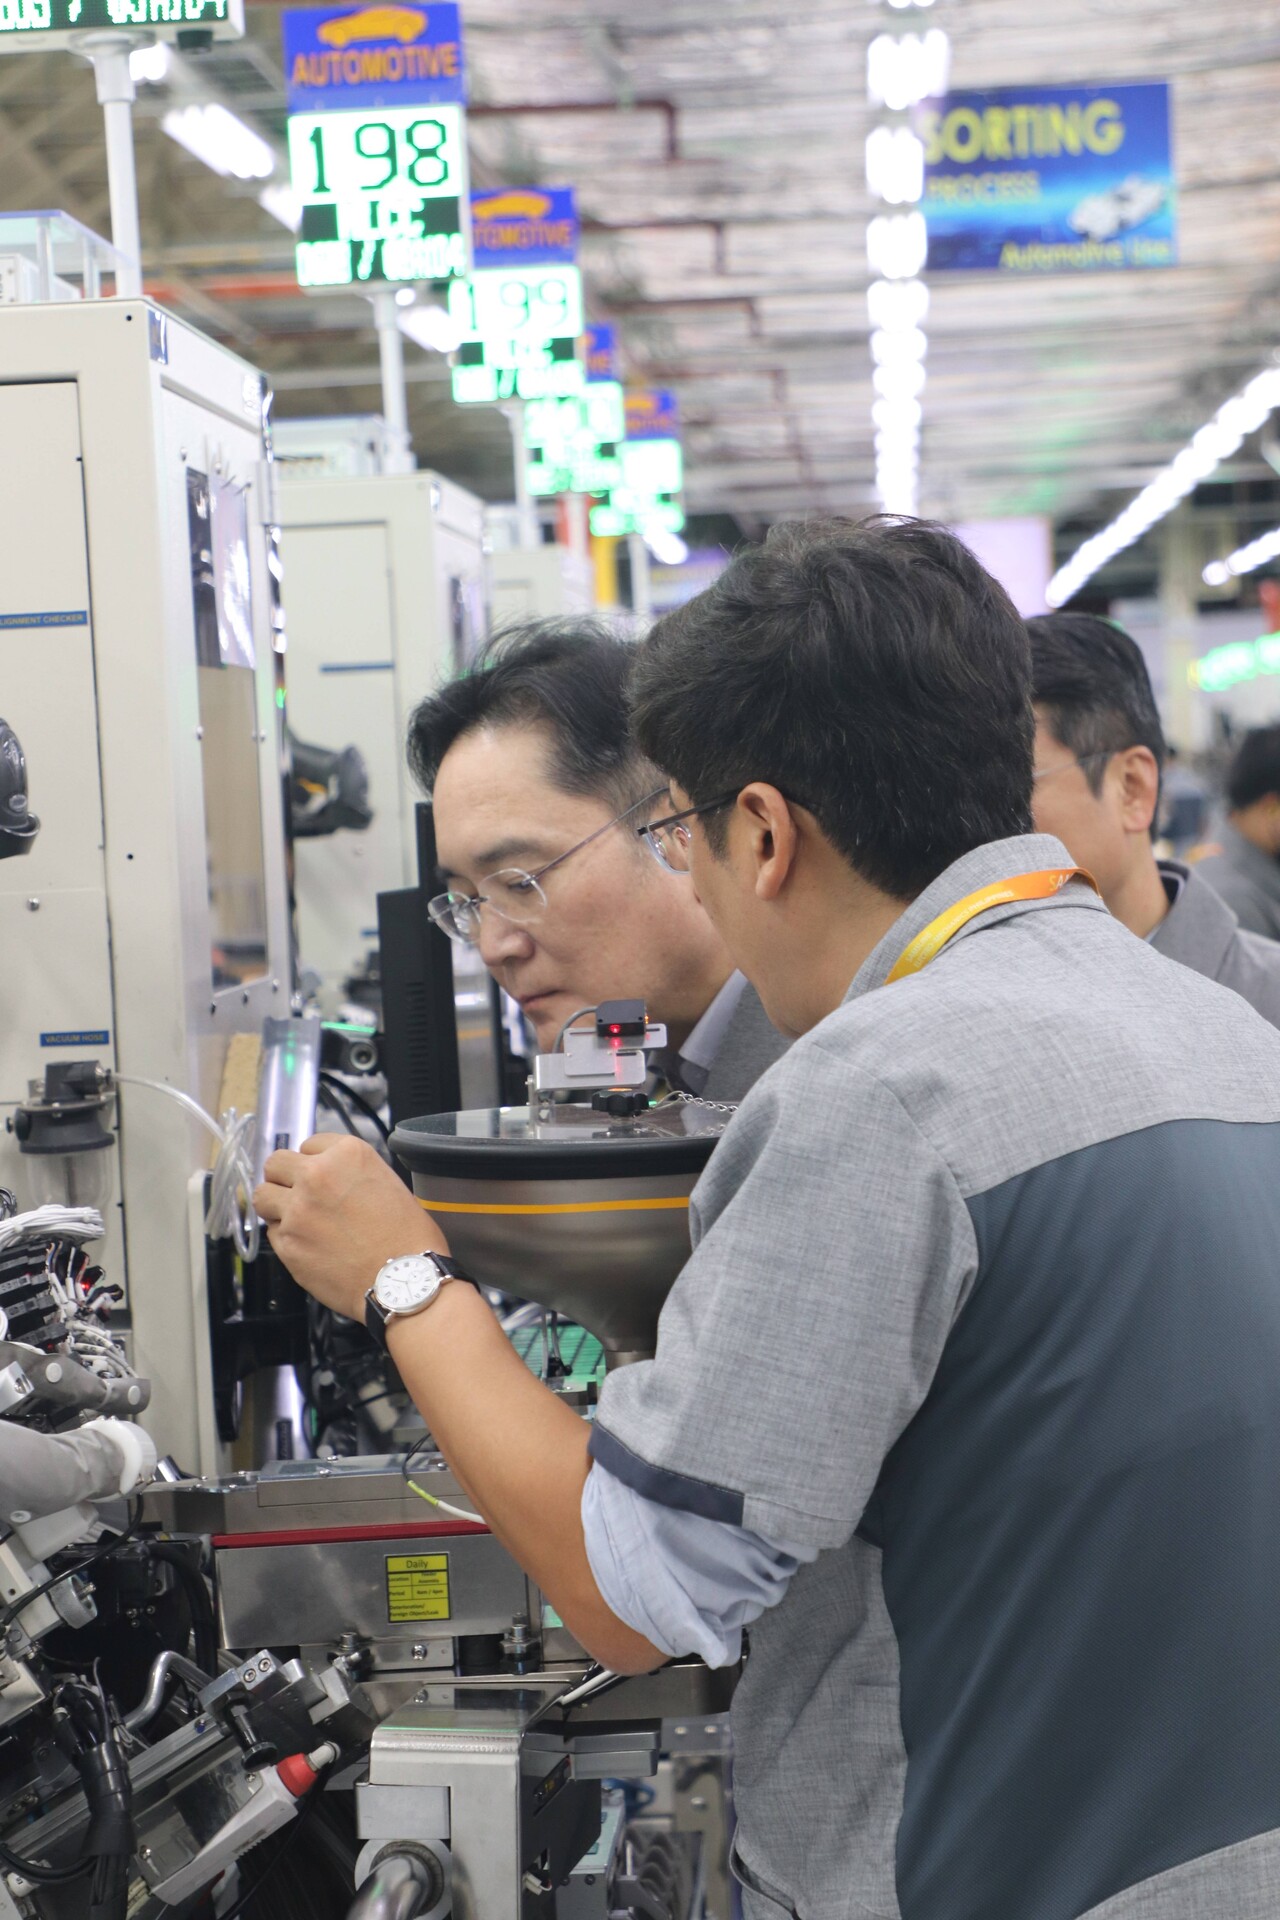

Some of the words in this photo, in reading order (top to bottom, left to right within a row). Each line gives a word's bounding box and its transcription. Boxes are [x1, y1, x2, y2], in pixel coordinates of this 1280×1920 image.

[292, 42, 460, 87] AUTOMOTIVE
[916, 100, 1124, 165] SORTING
[309, 119, 449, 193] 198
[43, 614, 83, 624] CHECKER
[45, 1034, 80, 1043] VACUUM
[81, 1033, 104, 1042] HOSE
[406, 1560, 428, 1569] Daily
